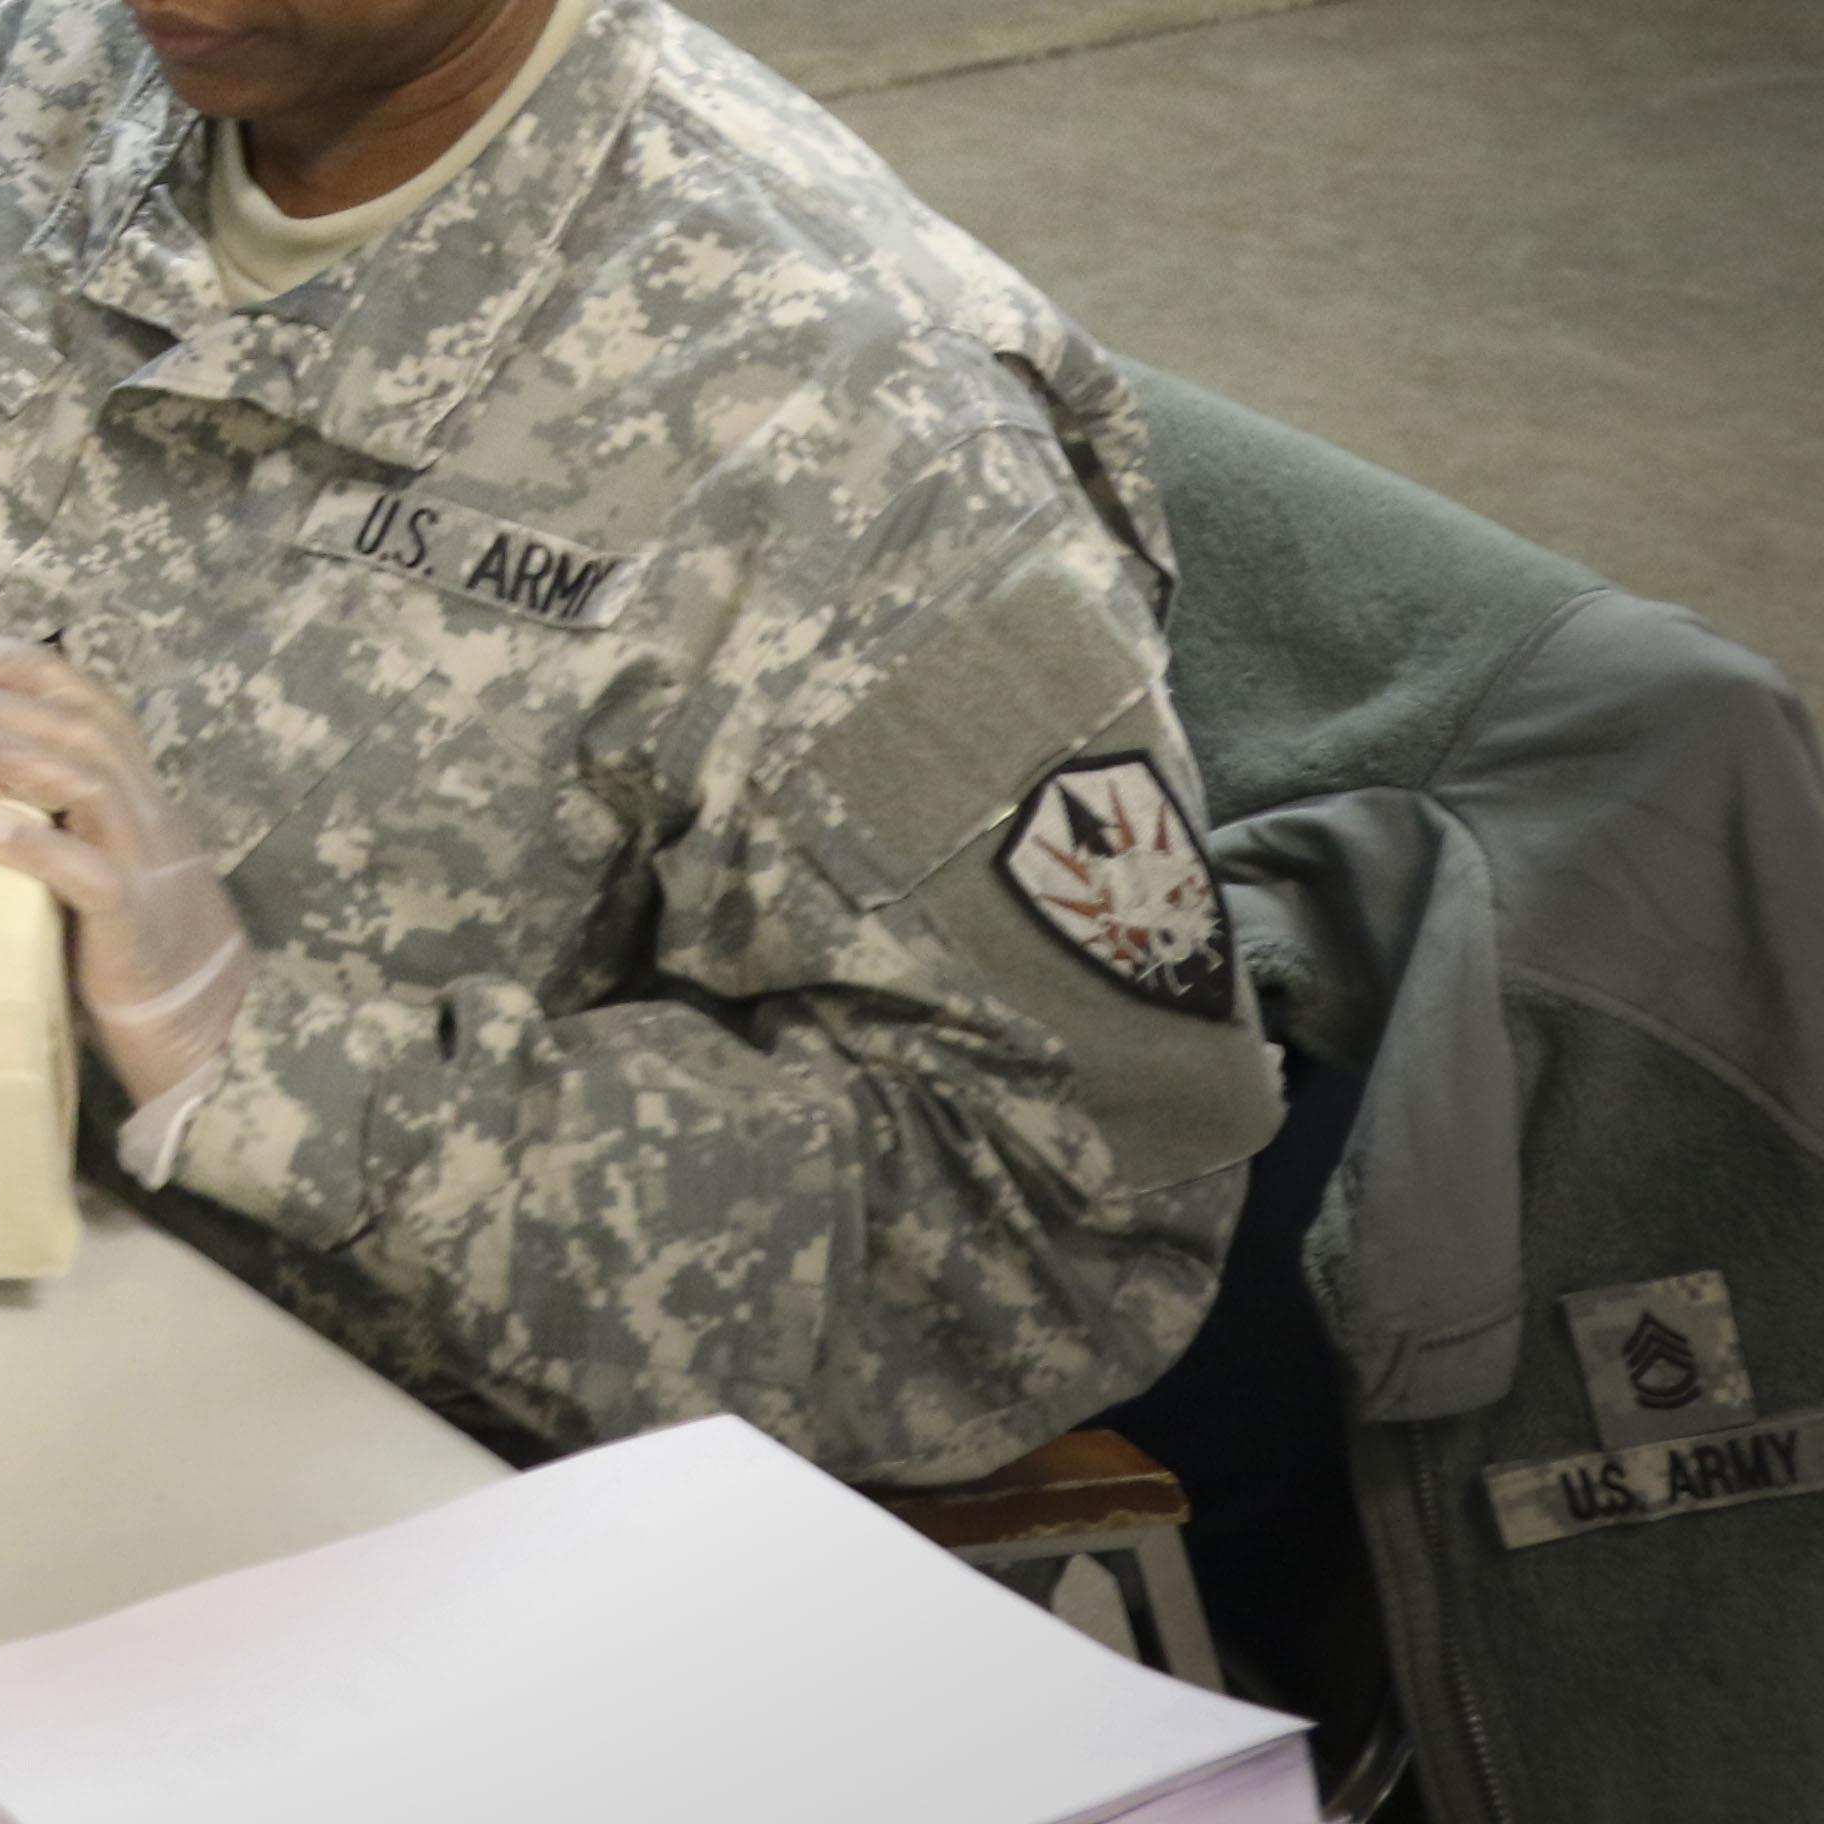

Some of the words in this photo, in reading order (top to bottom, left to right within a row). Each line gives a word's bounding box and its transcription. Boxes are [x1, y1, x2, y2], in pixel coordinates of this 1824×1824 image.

[355, 493, 440, 577] U.S.
[464, 531, 618, 620] ARMY
[1559, 1459, 1648, 1523] U.S.
[1664, 1426, 1800, 1506] ARMY
